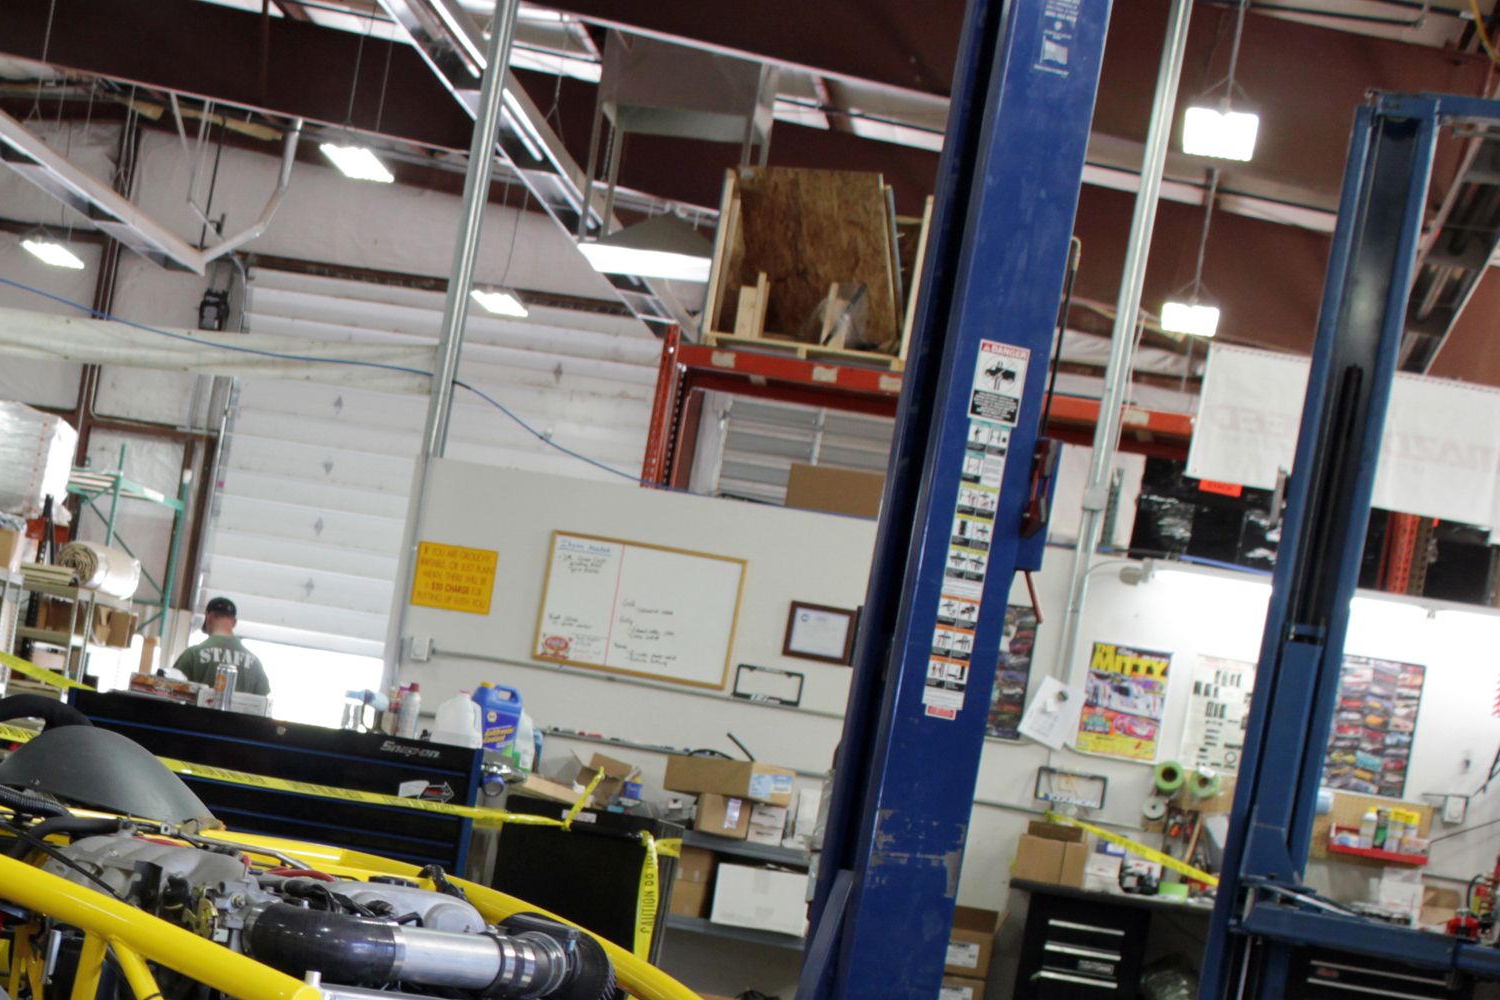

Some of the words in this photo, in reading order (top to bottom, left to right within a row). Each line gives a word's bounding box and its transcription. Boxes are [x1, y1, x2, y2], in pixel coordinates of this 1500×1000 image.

[199, 646, 254, 669] STAFF
[1091, 651, 1170, 678] MITTY
[380, 741, 440, 759] Snap-on
[645, 873, 654, 886] DO
[640, 891, 655, 934] CAUTION
